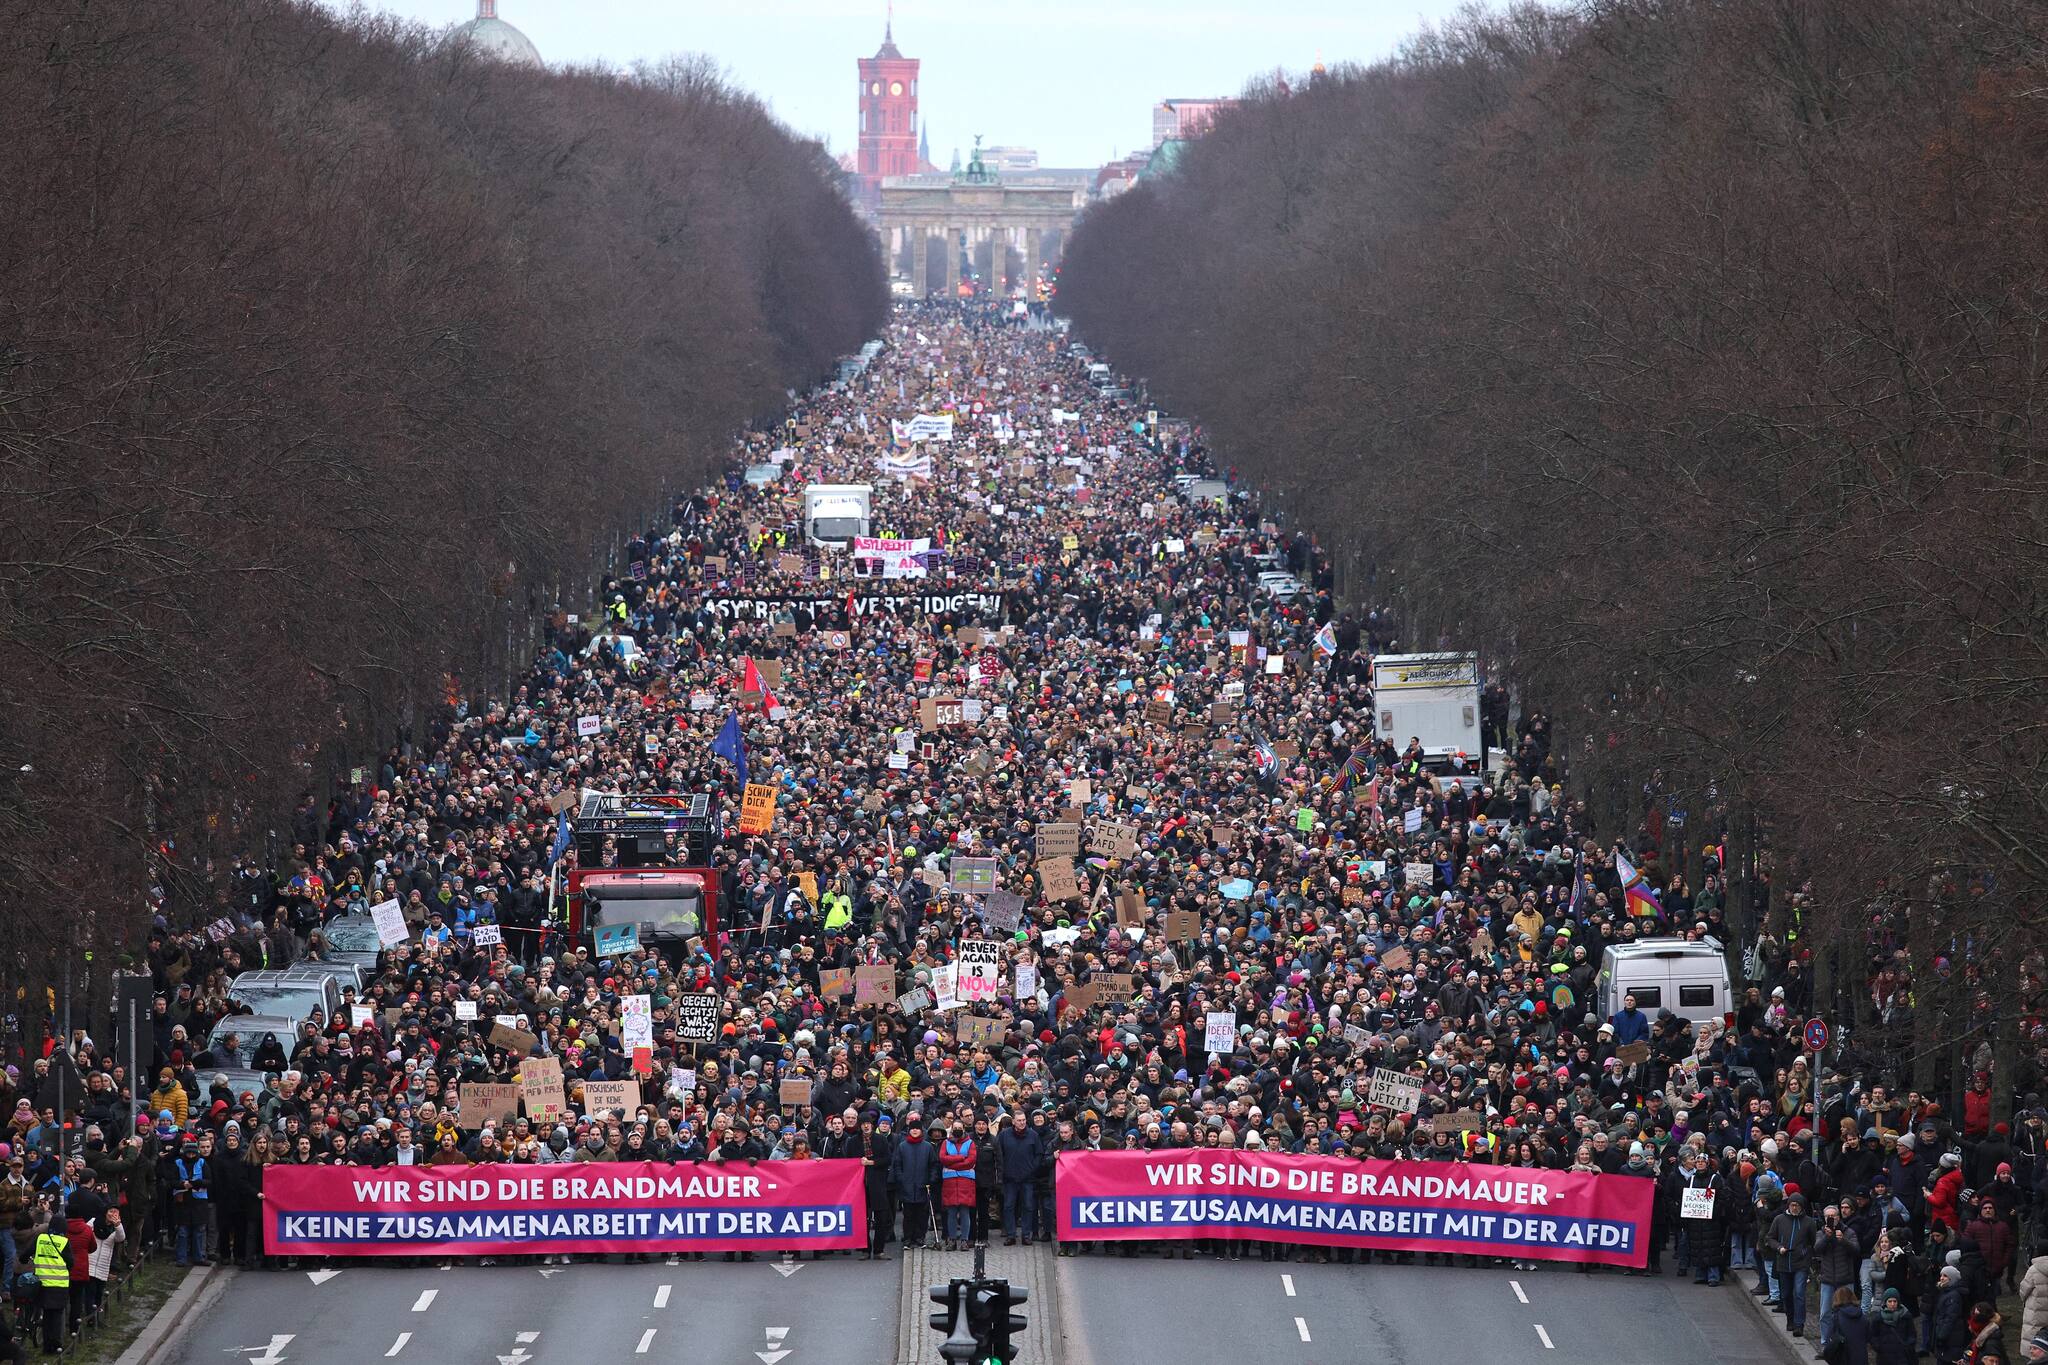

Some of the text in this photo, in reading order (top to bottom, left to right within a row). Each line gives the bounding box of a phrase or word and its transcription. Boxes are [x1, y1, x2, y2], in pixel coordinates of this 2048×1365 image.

[855, 538, 914, 551] ASYLRECHT
[937, 705, 961, 715] FCK
[582, 721, 597, 729] CDU
[1098, 824, 1125, 840] FCK
[1093, 839, 1116, 850] AFD
[1050, 877, 1073, 891] MERZ
[474, 926, 499, 936] 2+2=4
[961, 942, 997, 954] NEVER
[961, 953, 997, 964] AGAIN
[971, 965, 983, 977] IS
[959, 976, 997, 993] NOW
[682, 995, 716, 1007] GEGEN
[679, 1007, 717, 1021] RECHTS!
[1208, 1025, 1234, 1035] IDEEN
[1209, 1040, 1231, 1051] MERZ
[1375, 1069, 1423, 1090] NIE WIEDER
[527, 1087, 542, 1097] AFD
[586, 1084, 625, 1093] FASCHISMUS
[1375, 1082, 1393, 1093] IST
[594, 1096, 623, 1105] IST KEINE
[353, 1180, 412, 1203] WIR
[417, 1179, 490, 1202] SIND
[498, 1178, 545, 1201] DIE
[552, 1176, 762, 1200] BRANDMAUER
[1146, 1163, 1203, 1186] WIR
[1209, 1163, 1281, 1188] SIND
[1287, 1168, 1334, 1193] DIE
[1341, 1172, 1549, 1206] BRANDMAUER
[1683, 1202, 1710, 1210] WECHSEL
[285, 1210, 846, 1239] KEINE ZUSAMMENARBEIT MIT DER AFD!
[1079, 1199, 1630, 1249] KEINE ZUSAMMENARBEIT MIT DER AFD!
